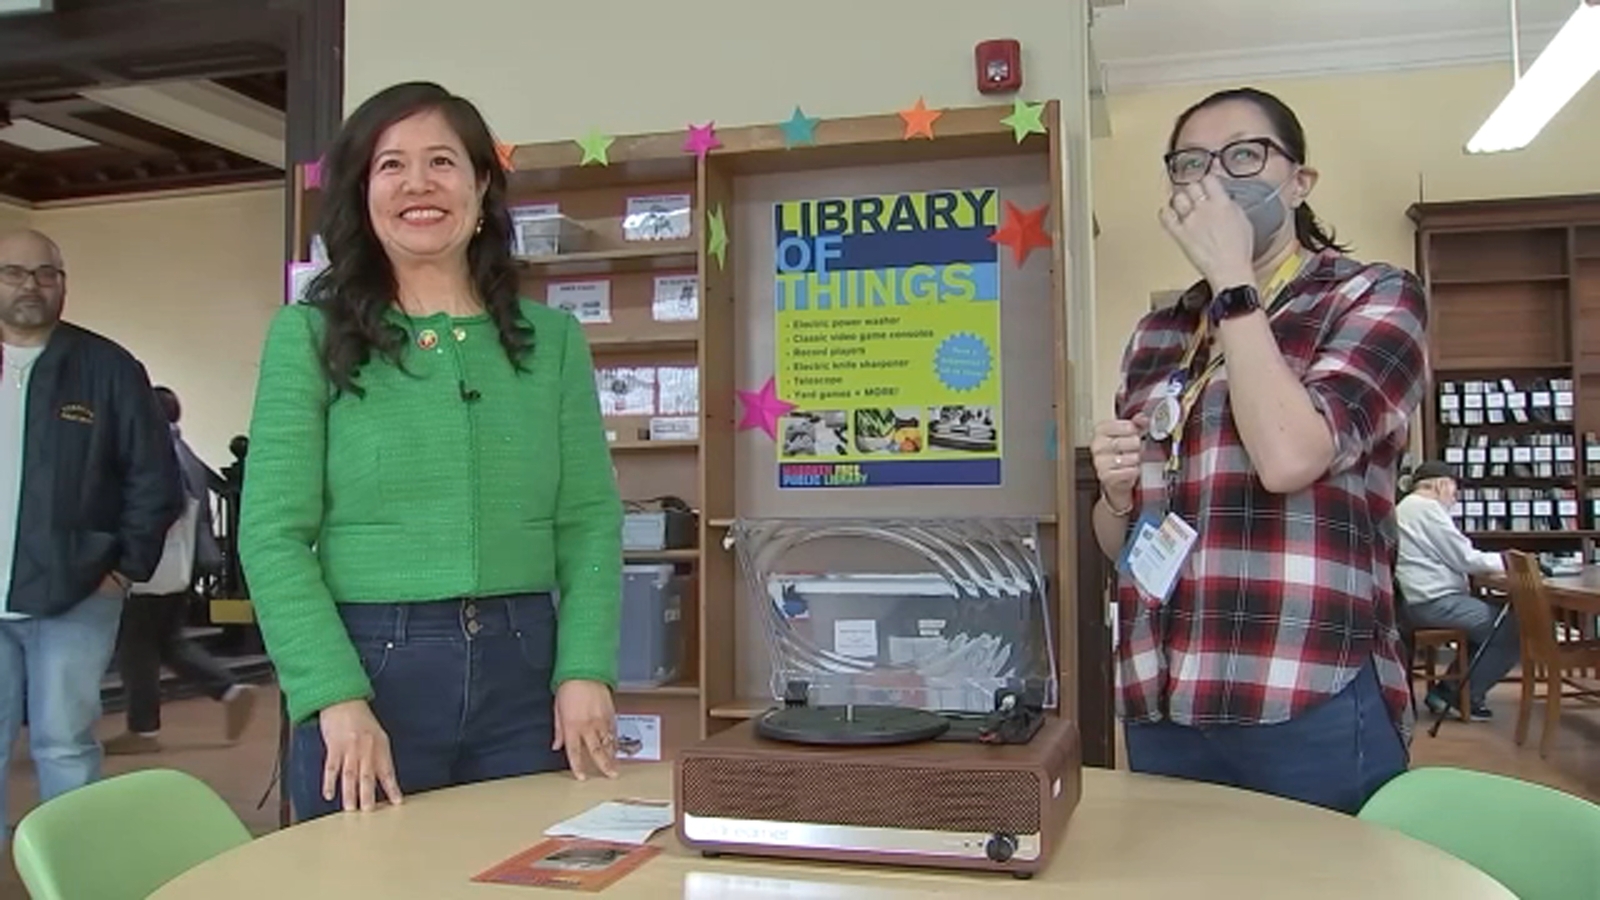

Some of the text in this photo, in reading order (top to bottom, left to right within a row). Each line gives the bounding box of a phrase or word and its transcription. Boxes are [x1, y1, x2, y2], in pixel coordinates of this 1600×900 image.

[775, 190, 996, 237] LIBRARY
[777, 232, 843, 275] OF
[775, 263, 976, 311] THINGS
[832, 318, 862, 328] power
[865, 316, 900, 326] washer
[793, 333, 828, 343] Classic
[830, 332, 857, 341] video
[860, 331, 886, 341] game
[793, 347, 828, 356] Record
[832, 360, 857, 370] knife
[860, 358, 909, 370] sharpener
[794, 376, 843, 386] Telescope
[794, 390, 817, 399] Yard
[819, 390, 851, 400] games
